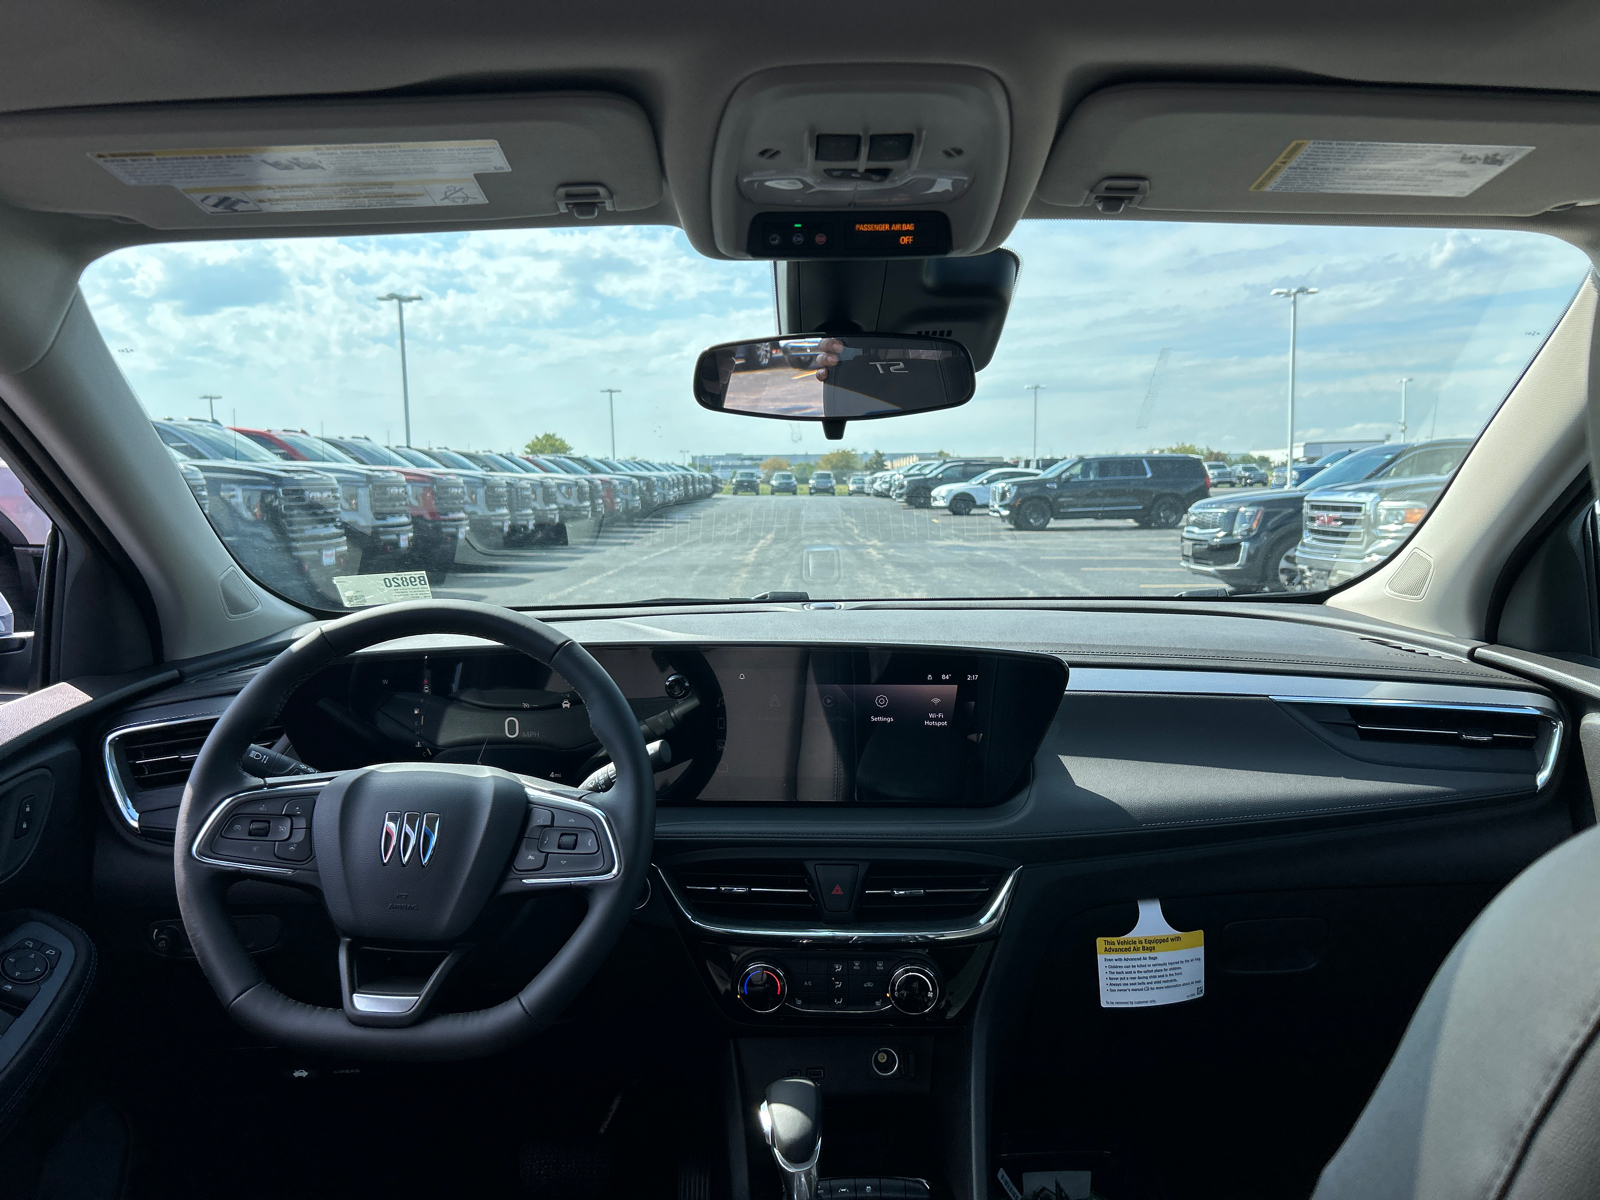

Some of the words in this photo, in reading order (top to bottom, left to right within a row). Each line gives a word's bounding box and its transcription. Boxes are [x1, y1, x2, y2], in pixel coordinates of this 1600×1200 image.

[855, 223, 890, 231] PASSENGER
[891, 223, 902, 231] AIR
[902, 223, 915, 231] BAG
[899, 235, 914, 245] OFF
[870, 715, 894, 723] Settings
[504, 716, 519, 739] 0
[1144, 937, 1169, 945] Equipped
